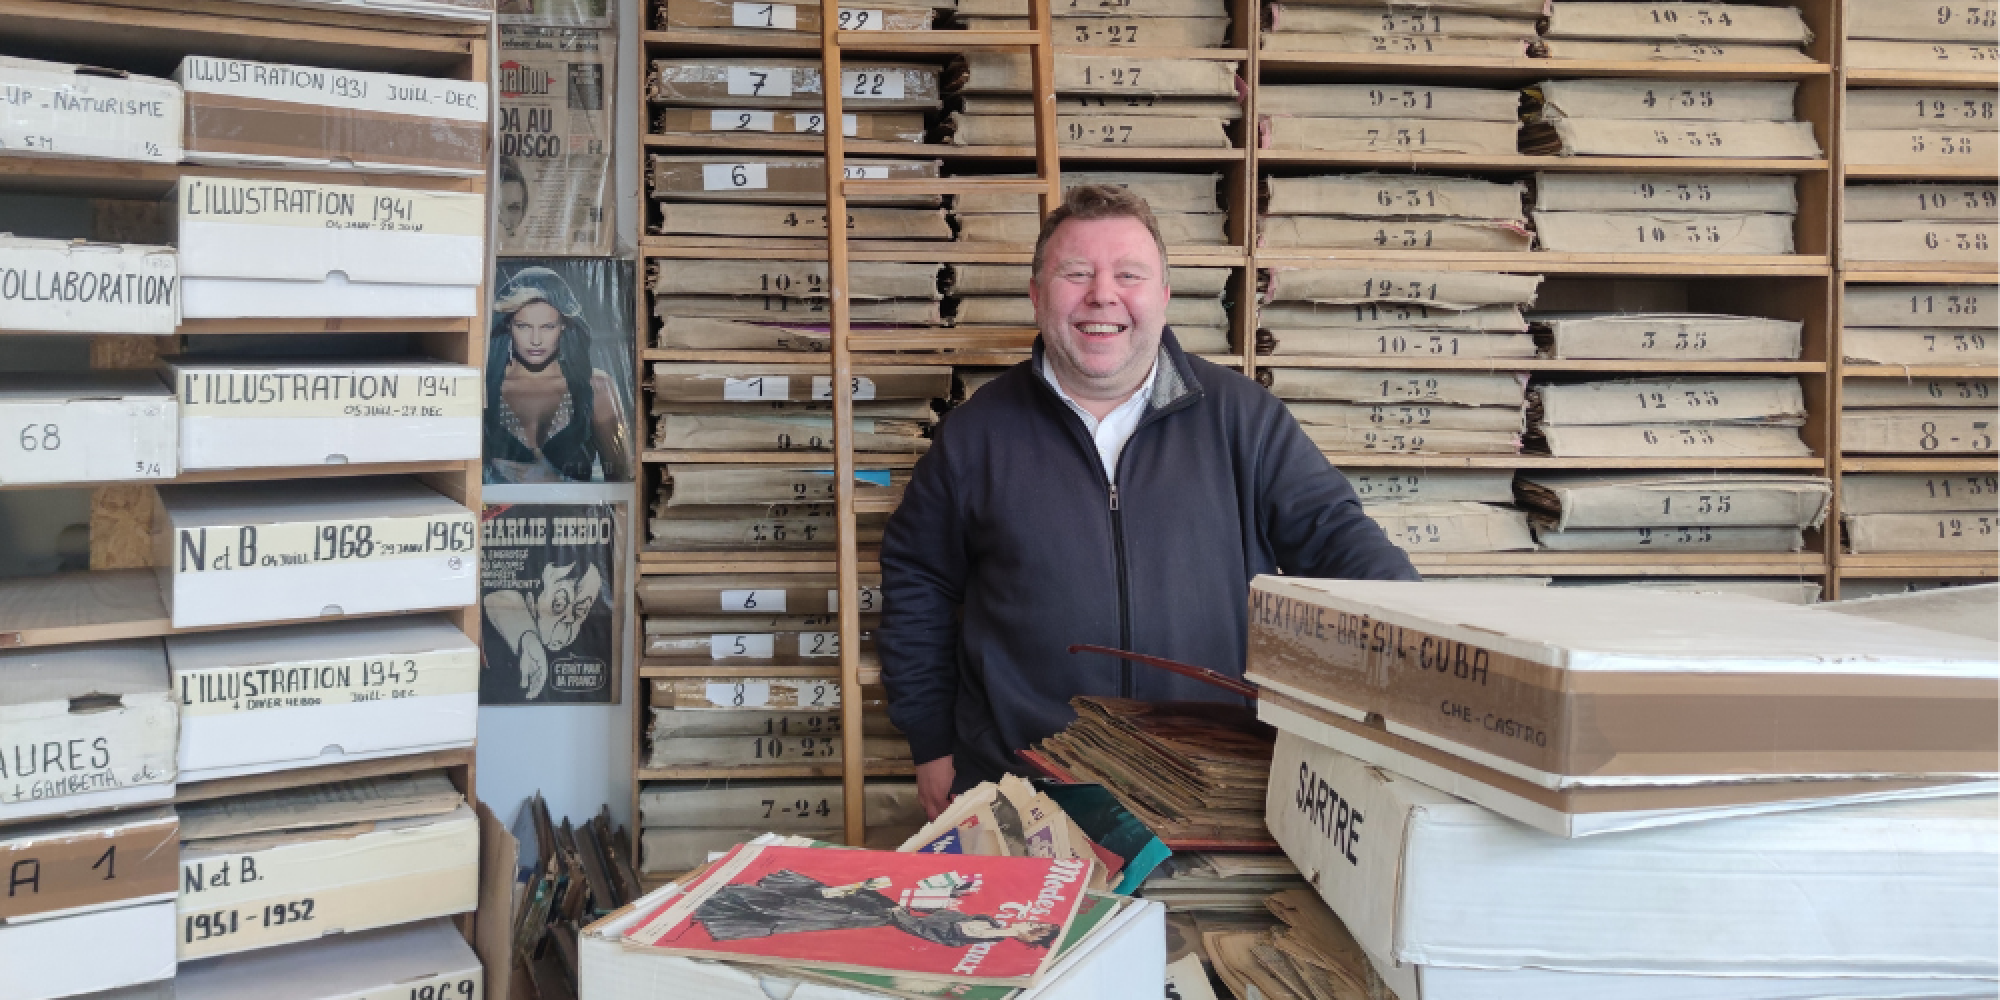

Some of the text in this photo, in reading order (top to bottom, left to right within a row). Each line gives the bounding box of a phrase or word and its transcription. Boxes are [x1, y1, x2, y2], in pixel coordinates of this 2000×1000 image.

[757, 5, 773, 27] 1
[1075, 25, 1138, 43] 3-27
[189, 58, 325, 91] ILLUSTRATION
[330, 75, 368, 98] 1931
[749, 72, 885, 96] 7 22
[1083, 66, 1141, 86] 1-27
[53, 91, 165, 118] NATURISME
[1369, 89, 1433, 110] 9-31
[526, 107, 553, 133] AU
[1068, 123, 1133, 143] 9-27
[1367, 128, 1427, 145] 7-31
[500, 133, 561, 158] DISCO
[731, 165, 748, 187] 6
[187, 180, 413, 221] L'ILLUSTRATION 1941
[1377, 190, 1435, 207] 6-31
[1373, 229, 1433, 247] 4-31
[0, 266, 177, 307] OLLABORATION
[759, 273, 823, 292] 10-2
[1363, 278, 1437, 301] 12-31
[1378, 335, 1459, 355] 10-31
[184, 371, 457, 406] L'ILLUSTRATION 1941
[748, 377, 763, 397] 1
[1379, 378, 1438, 398] 1-32
[20, 424, 61, 451] 68
[1359, 475, 1419, 493] 3-32
[552, 517, 611, 545] HEBDO
[1937, 517, 1998, 538] 12-3
[181, 527, 207, 573] N
[212, 545, 233, 571] et
[238, 526, 258, 567] B
[313, 523, 374, 561] 1968
[425, 521, 475, 553] 1969
[743, 591, 758, 609] 6
[733, 635, 747, 655] 5
[181, 659, 418, 706] L'ILLUSTRATION 1943
[732, 683, 745, 707] 8
[753, 737, 836, 759] 10-23
[761, 799, 831, 819] 7-24
[1296, 760, 1364, 867] SARTRE
[8, 845, 117, 898] A 1
[210, 860, 231, 888] et
[185, 909, 239, 945] 1951
[263, 897, 316, 929] 1952
